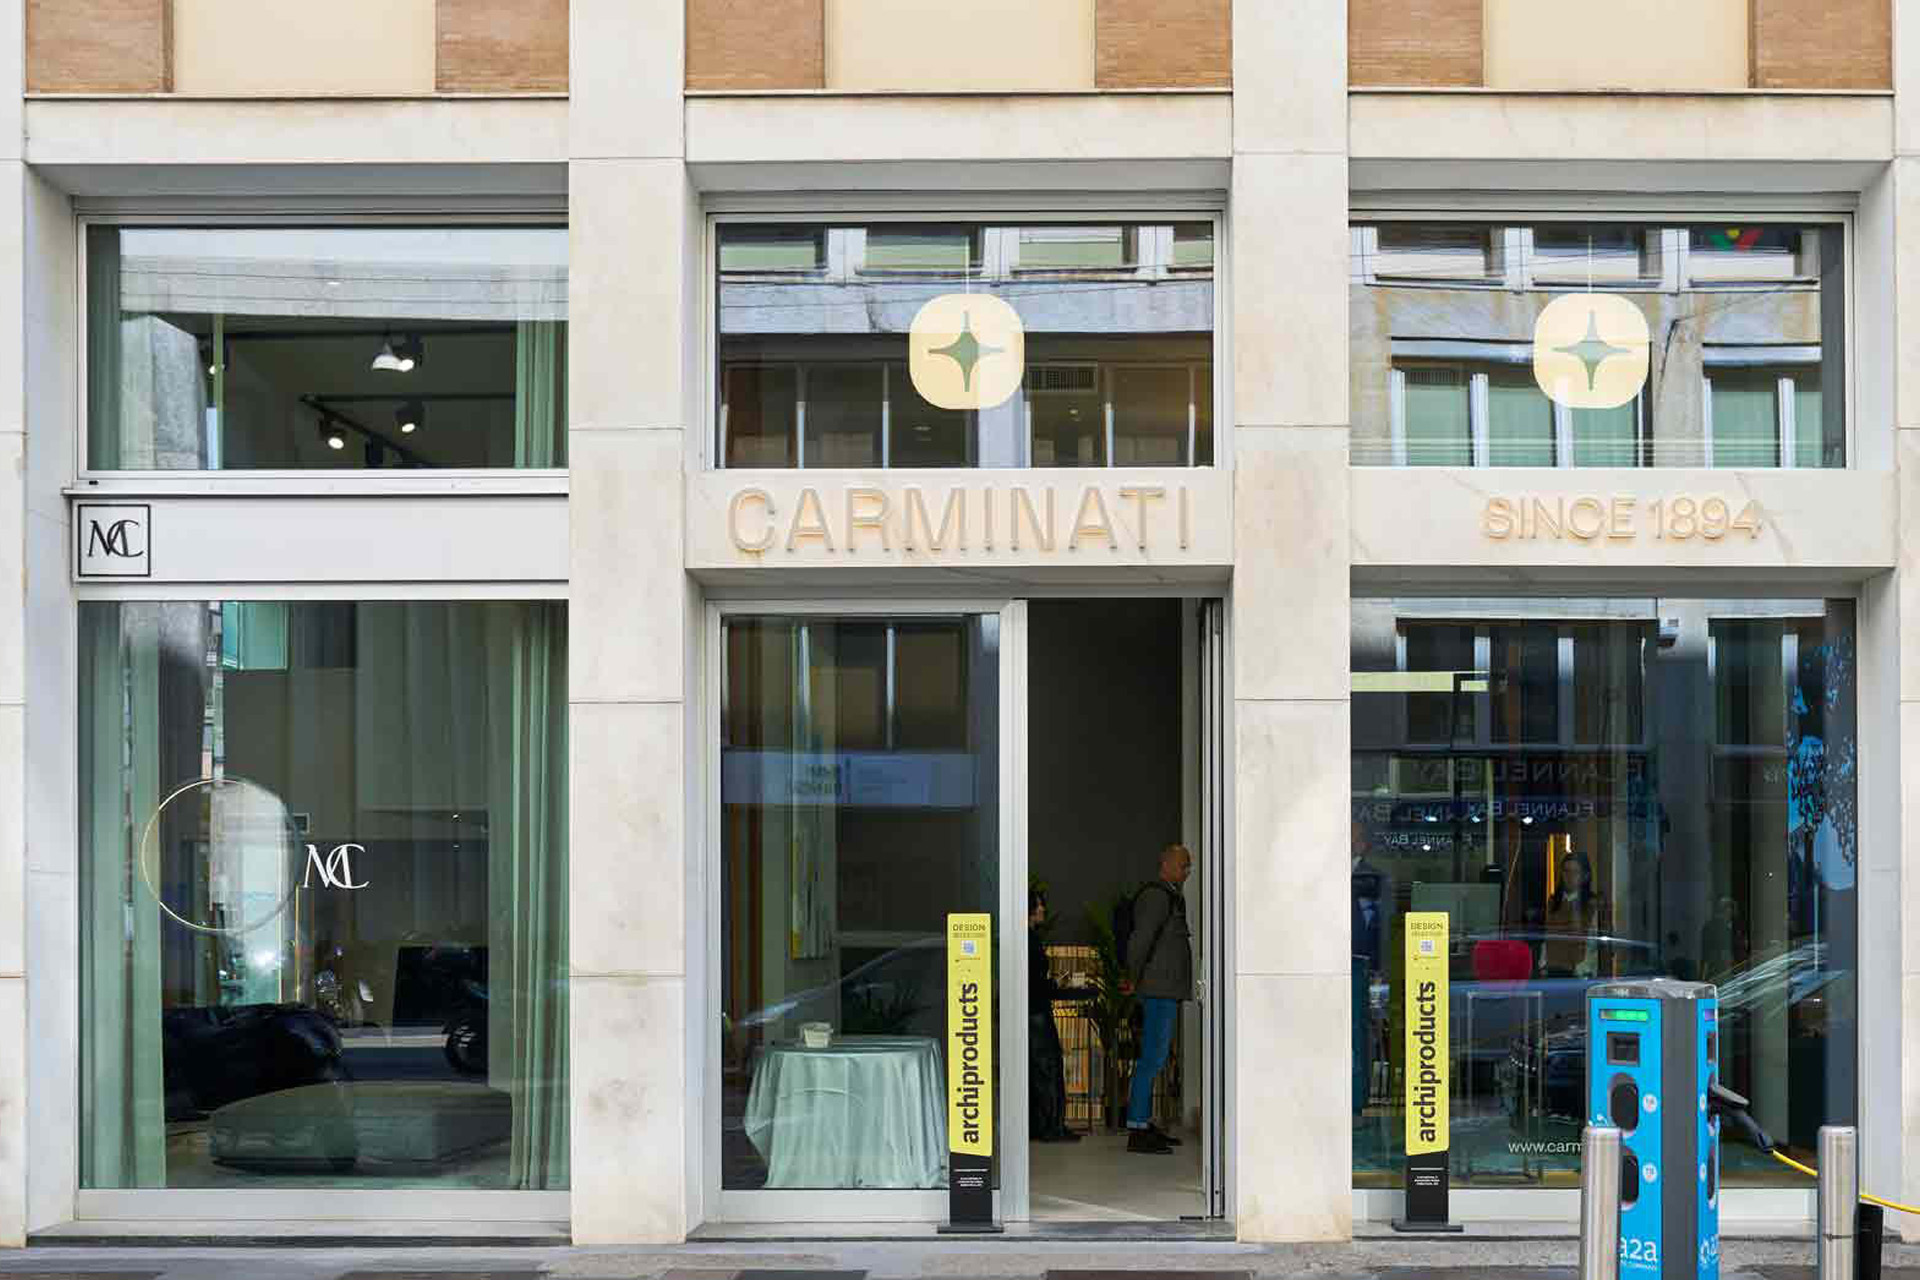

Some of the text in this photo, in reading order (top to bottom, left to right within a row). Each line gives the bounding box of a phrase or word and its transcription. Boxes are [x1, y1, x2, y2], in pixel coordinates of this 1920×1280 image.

[727, 486, 1189, 557] CARMINATI
[1484, 496, 1765, 541] SINCE 1894
[1410, 922, 1444, 931] DESIGN
[955, 982, 985, 1144] archiproducts
[1413, 981, 1442, 1143] archiproducts
